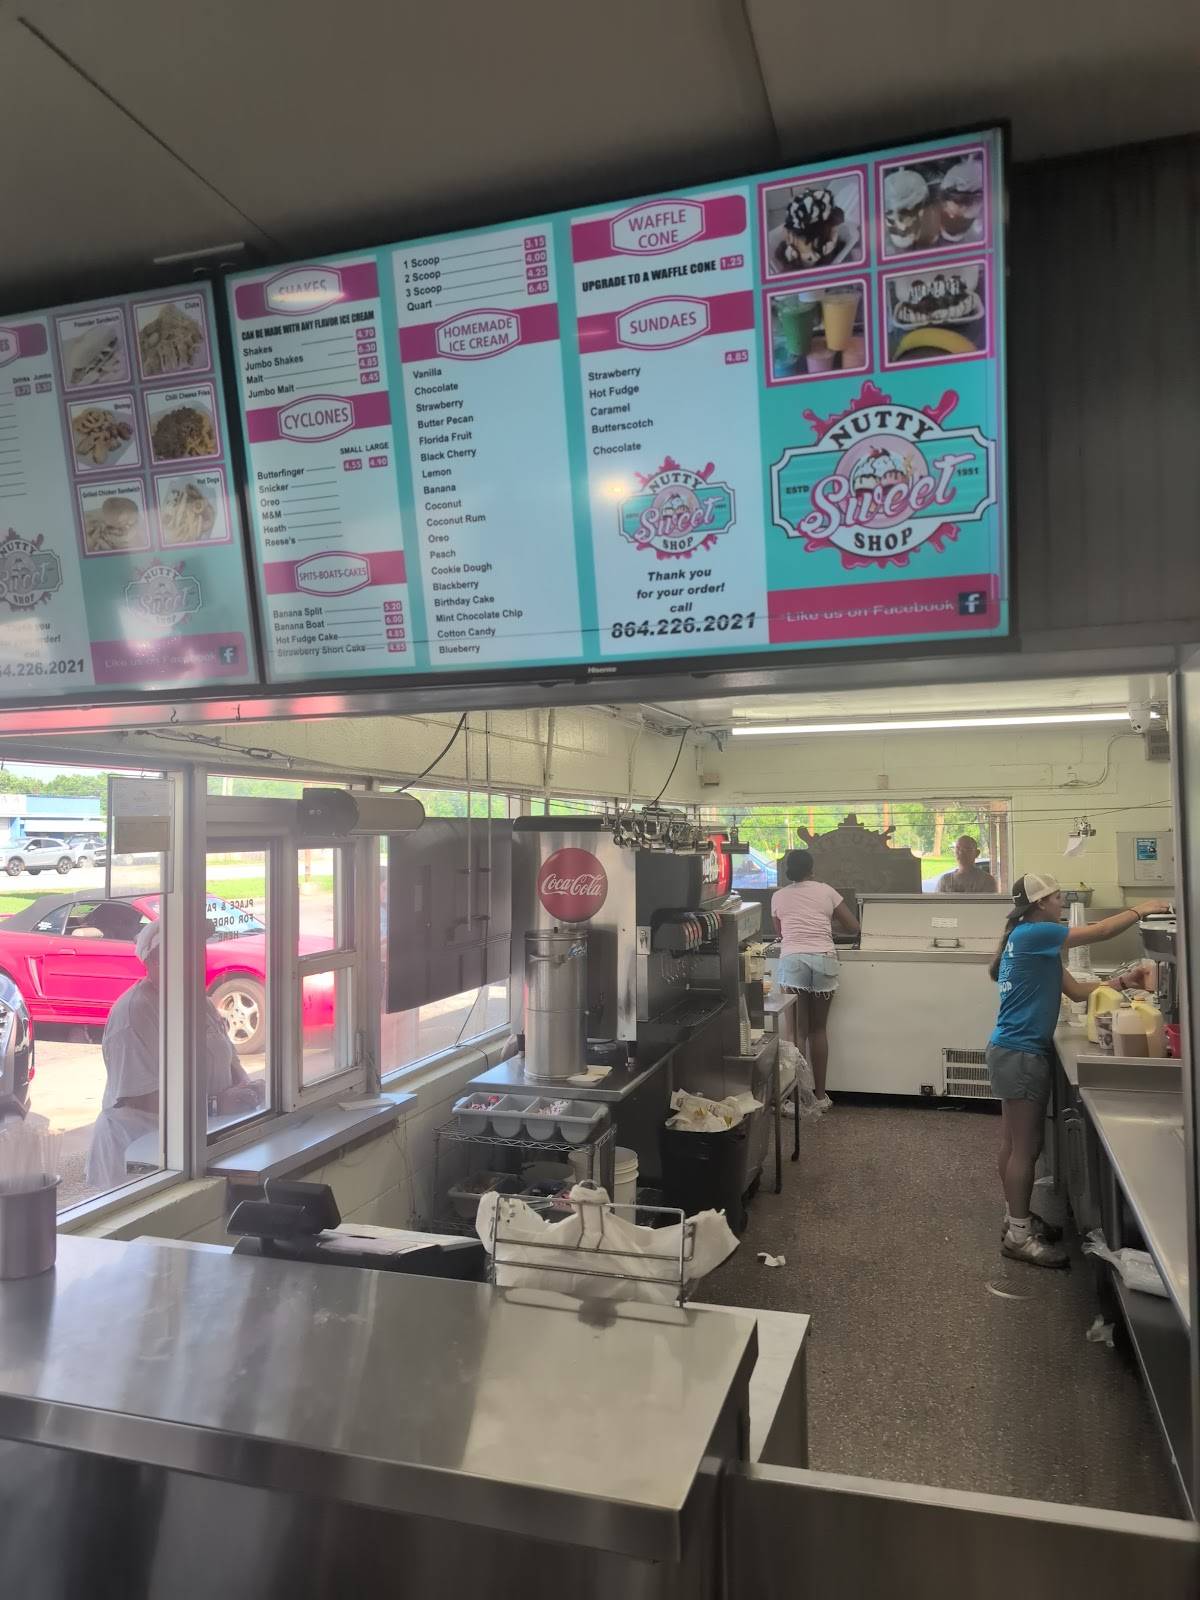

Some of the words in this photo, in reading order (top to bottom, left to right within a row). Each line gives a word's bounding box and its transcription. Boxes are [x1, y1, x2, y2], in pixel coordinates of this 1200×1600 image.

[628, 209, 686, 232] WAFFLE
[638, 229, 679, 248] CONE
[403, 260, 408, 269] 1
[411, 255, 440, 268] Scoop
[404, 274, 410, 283] 2
[412, 269, 441, 282] Scoop
[526, 252, 546, 263] 4.00
[582, 275, 626, 292] UPGRADE
[628, 273, 641, 285] TO
[642, 271, 650, 282] A
[651, 265, 688, 281] WAFFLE
[690, 259, 717, 274] CONE
[721, 255, 743, 268] 1.25
[406, 288, 411, 297] 3
[413, 284, 442, 296] Scoop
[407, 299, 433, 311] Quart
[528, 281, 548, 293] 6.45
[242, 331, 254, 340] CAN
[255, 329, 264, 339] BE
[264, 326, 282, 337] MADE
[283, 323, 300, 334] WITH
[301, 320, 314, 331] ANY
[315, 317, 339, 329] FLAVOR
[339, 314, 350, 325] ICE
[351, 310, 375, 322] CREAM
[443, 317, 513, 339] HOMEMADE
[629, 311, 697, 335] SUNDAES
[449, 340, 466, 353] ICE
[469, 333, 510, 350] CREAM
[242, 345, 273, 357] Shakes
[245, 359, 272, 371] Jumbo
[274, 354, 304, 366] Shakes
[246, 374, 264, 384] Malt
[412, 367, 442, 379] Vanilla
[588, 366, 641, 382] Strawberry
[248, 387, 275, 399] Jumbo
[277, 384, 295, 393] Malt
[361, 372, 379, 383] 6.45
[414, 382, 459, 396] Chocolate
[589, 389, 607, 399] Hot
[609, 384, 640, 397] Fudge
[416, 399, 464, 413] Strawberry
[590, 403, 631, 417] Caramel
[284, 407, 350, 430] CYCLONES
[417, 417, 445, 429] Butter
[446, 414, 474, 425] Pecan
[591, 418, 654, 434] Butterscotch
[829, 410, 936, 449] NUTTY
[419, 433, 449, 446] Florida
[451, 431, 472, 442] Fruit
[340, 446, 364, 455] SMALL
[365, 442, 390, 452] LARGE
[420, 451, 445, 462] Black
[447, 448, 477, 459] Cherry
[592, 442, 642, 456] Chocolate
[257, 467, 305, 480] Butterfinger
[422, 468, 452, 479] Lemon
[258, 482, 289, 494] Snicker
[423, 484, 457, 495] Banana
[649, 472, 703, 494] NUTTY
[260, 498, 280, 508] Oreo
[796, 453, 977, 540] Sweet
[425, 499, 463, 511] Coconut
[262, 510, 282, 520] M&M
[426, 515, 463, 527] Coconut
[465, 513, 486, 523] Rum
[633, 495, 724, 544] Sweet
[263, 523, 287, 534] Heath
[265, 536, 297, 547] Reese's
[428, 533, 450, 544] Oreo
[662, 536, 694, 551] SHOP
[854, 527, 913, 552] SHOP
[430, 549, 457, 559] Peach
[143, 567, 180, 582] NUTTY
[431, 565, 461, 576] Cookie
[463, 562, 493, 573] Dough
[647, 569, 686, 582] Thank
[689, 569, 712, 581] you
[432, 580, 479, 591] Blackberry
[636, 589, 653, 600] for
[656, 587, 684, 600] your
[687, 582, 726, 595] order!
[434, 597, 471, 607] Birthday
[472, 594, 495, 604] Cake
[669, 602, 693, 613] call
[273, 609, 303, 619] Banana
[304, 606, 323, 617] Split
[435, 613, 455, 622] Mint
[456, 610, 500, 621] Chocolate
[502, 608, 524, 619] Chip
[785, 610, 819, 623] Like
[823, 609, 844, 621] us
[846, 606, 869, 619] on
[872, 601, 955, 616] Facebook
[274, 622, 304, 632] Banana
[305, 619, 325, 629] Boat
[386, 615, 403, 624] 6.00
[610, 611, 757, 639] 864.226.2021
[276, 635, 290, 645] Hot
[291, 633, 317, 645] Fudge
[318, 632, 339, 642] Cake
[437, 629, 466, 639] Cotton
[467, 627, 497, 638] Candy
[277, 646, 320, 657] Strawberry
[322, 645, 344, 655] Short
[345, 644, 366, 653] Cake
[439, 644, 481, 654] Blueberry
[541, 873, 606, 896] Coca-Cola
